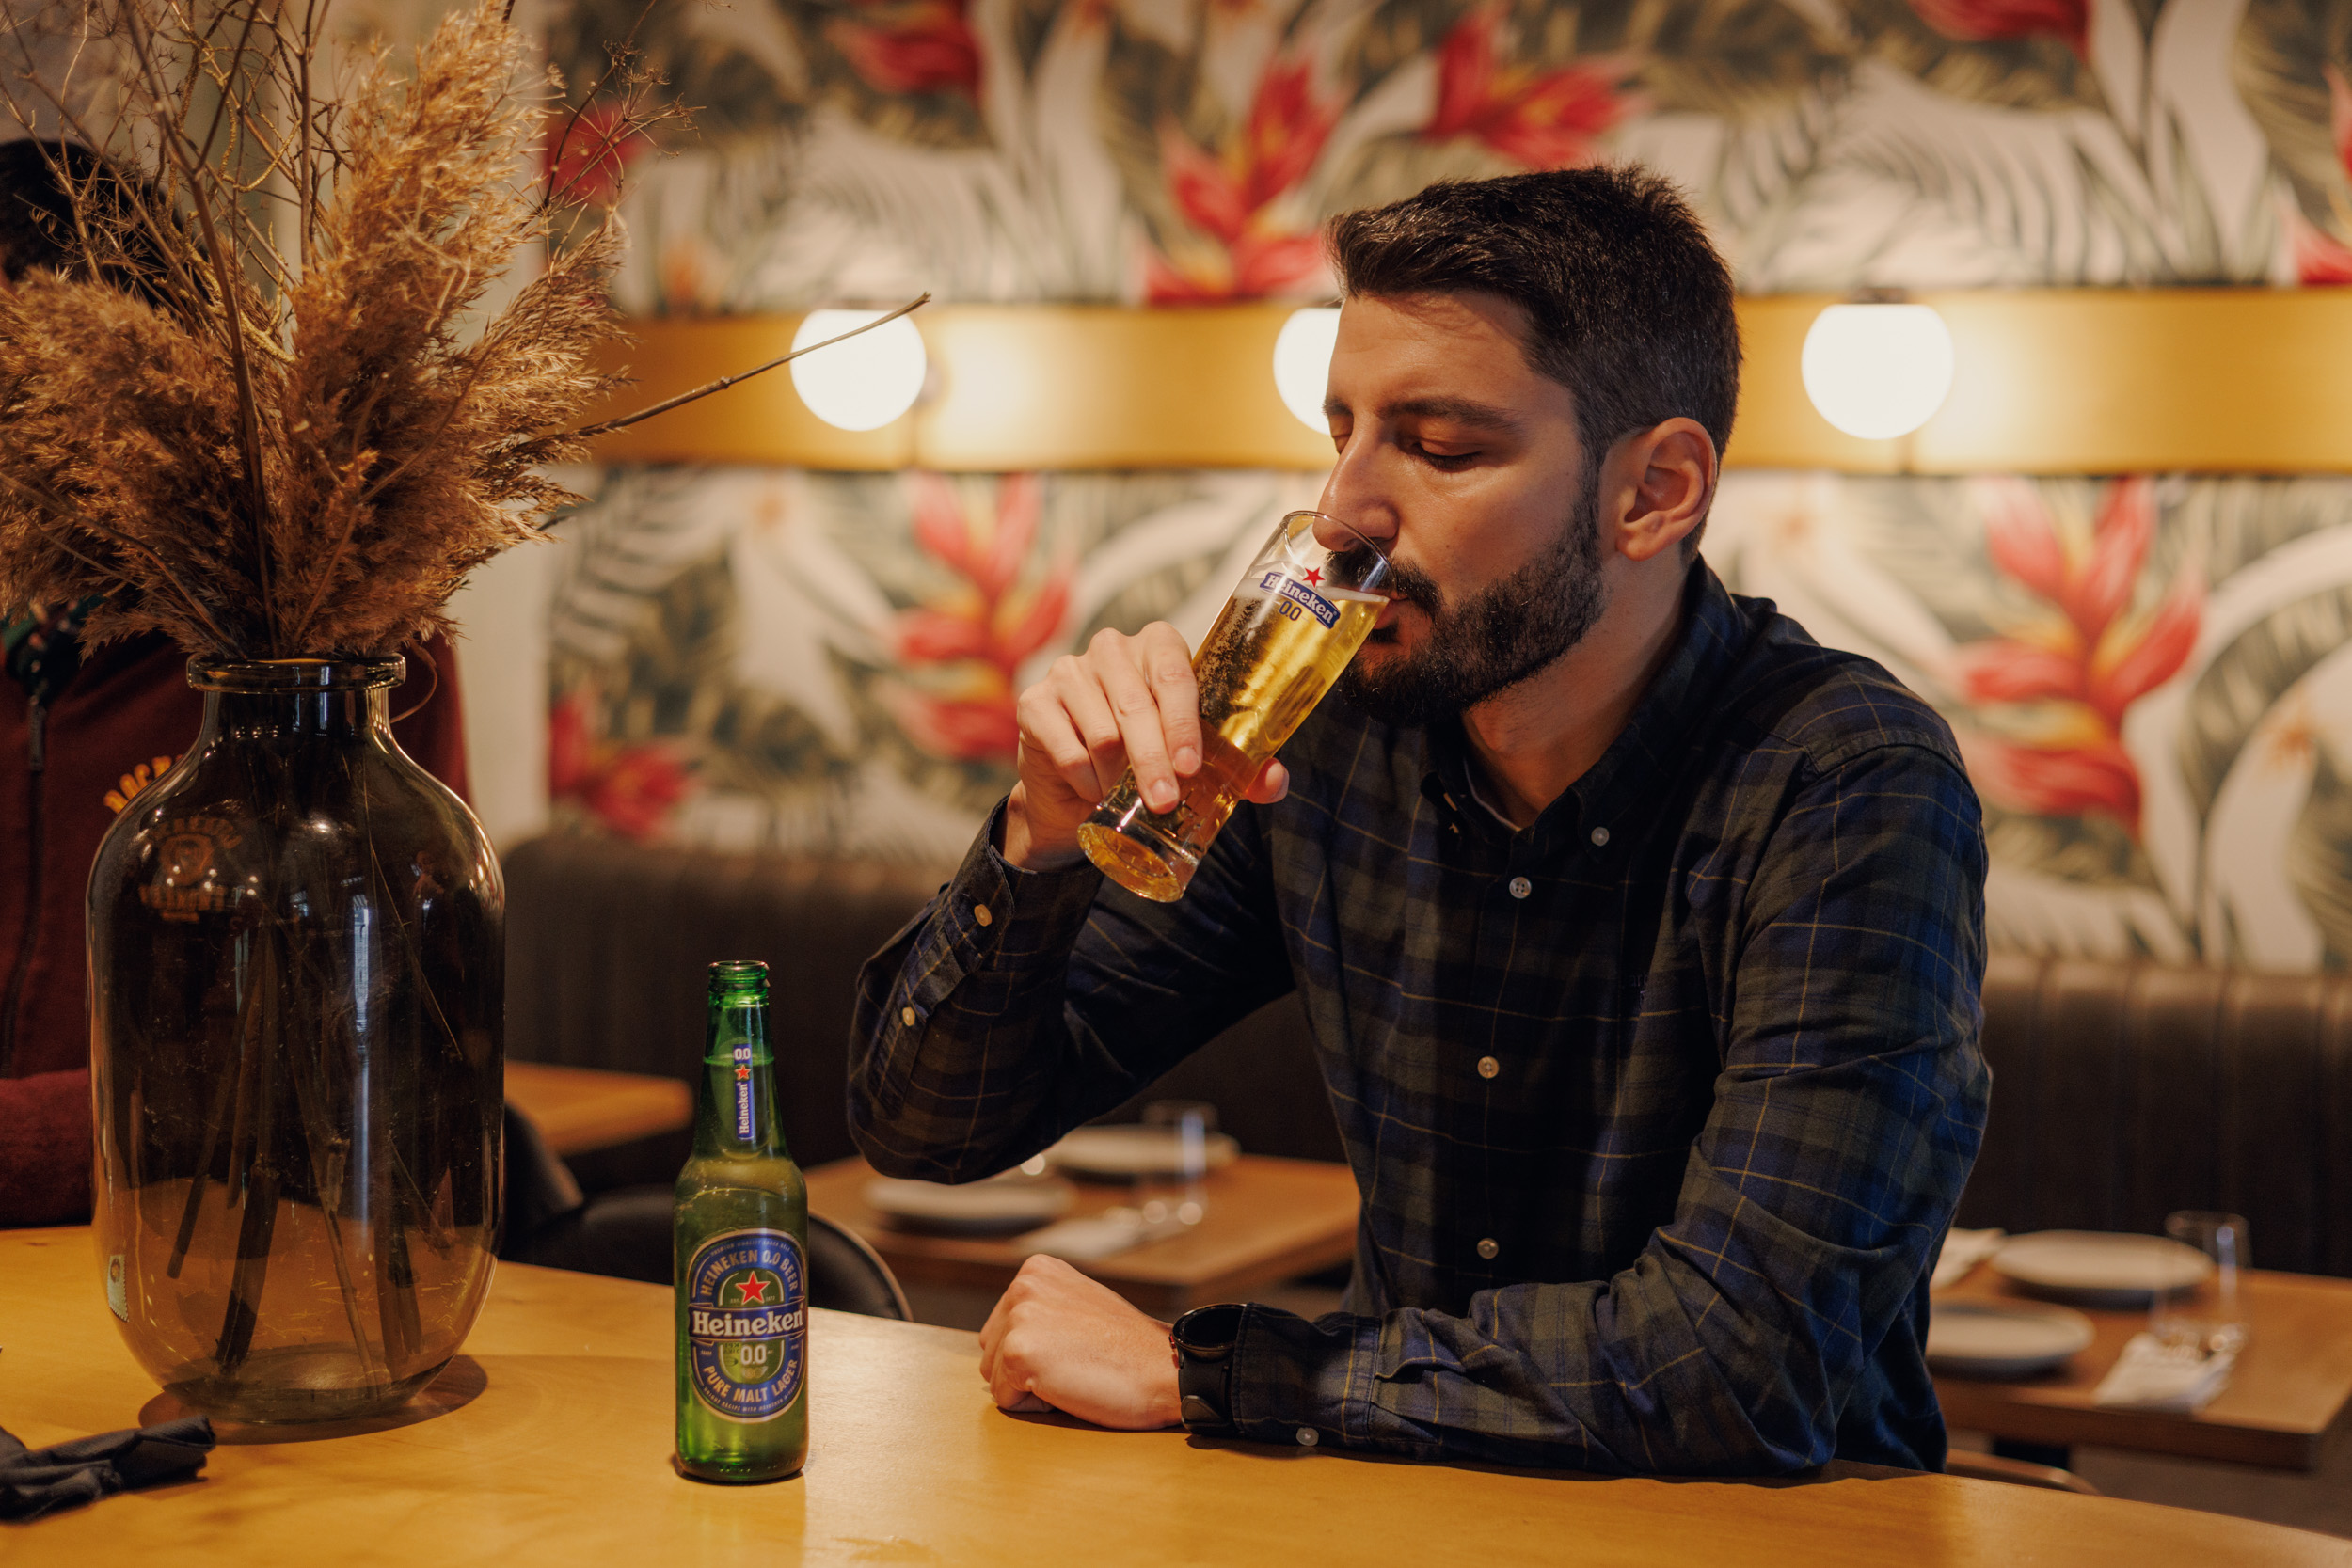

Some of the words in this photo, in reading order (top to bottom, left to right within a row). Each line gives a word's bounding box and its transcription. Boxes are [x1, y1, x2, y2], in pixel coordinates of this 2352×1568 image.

[1279, 600, 1302, 622] 0.0
[738, 1083, 750, 1134] Heineken
[700, 1249, 758, 1297] HEINEKEN
[761, 1249, 782, 1266] 0.0
[781, 1258, 799, 1291] BEER
[692, 1308, 803, 1337] Heineken
[740, 1343, 767, 1365] 0.0
[703, 1365, 732, 1398] PURE
[733, 1386, 768, 1402] MALT
[771, 1359, 798, 1396] LAGER
